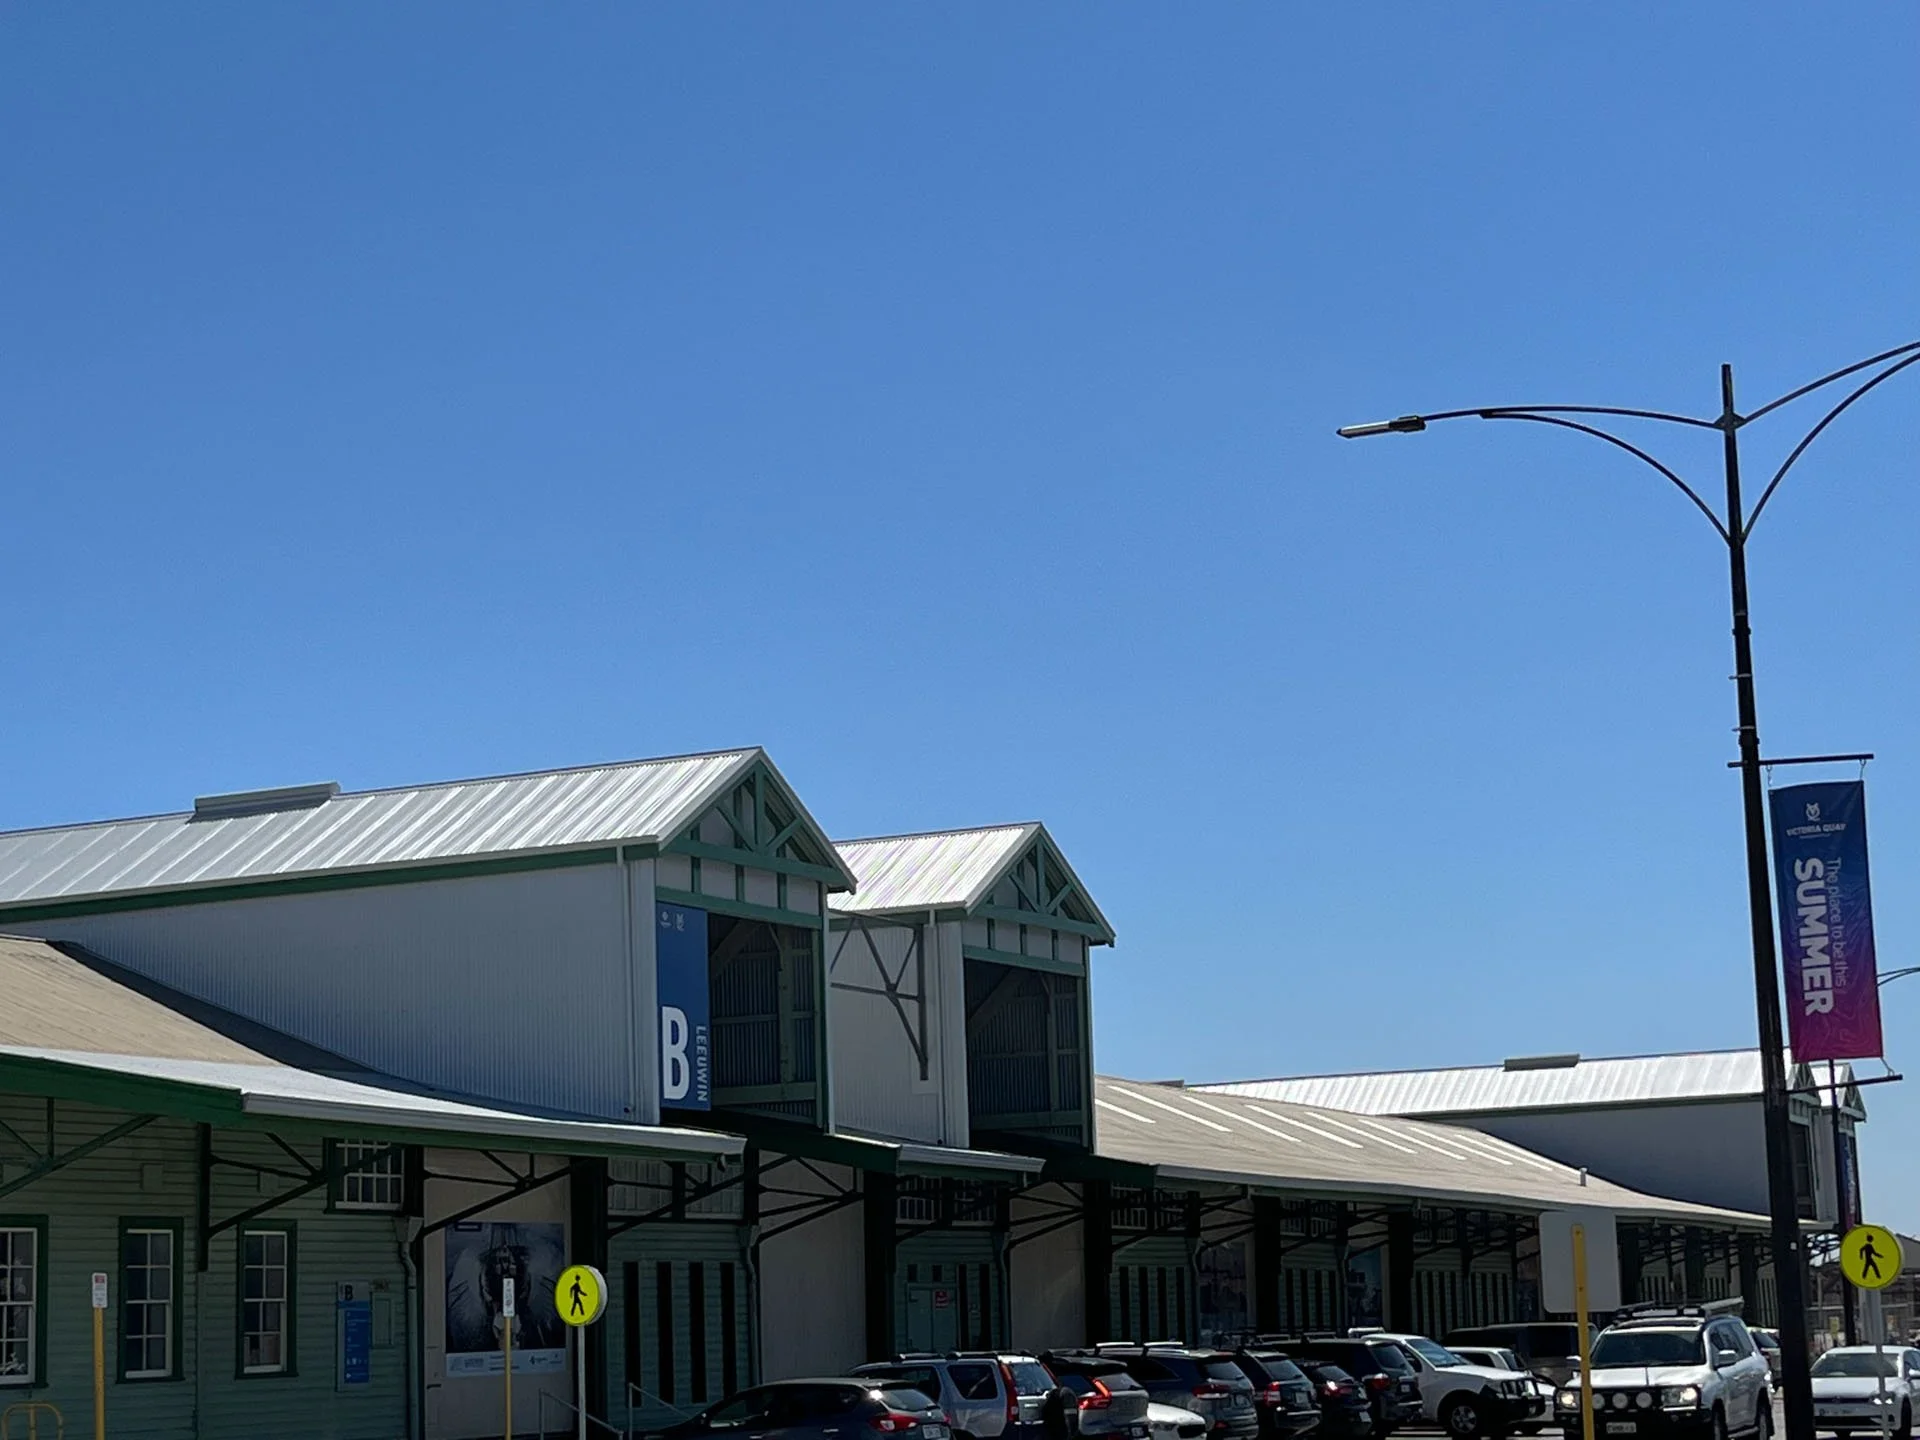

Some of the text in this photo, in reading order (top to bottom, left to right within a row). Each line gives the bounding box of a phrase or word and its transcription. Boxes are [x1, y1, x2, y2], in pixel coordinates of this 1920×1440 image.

[1786, 825, 1821, 836] VICTORIA
[1823, 823, 1846, 832] QUAY
[1794, 857, 1834, 1016] SUMMER
[1824, 857, 1849, 987] The place to be this
[662, 1005, 690, 1100] B
[696, 1025, 708, 1102] LEEUWIN
